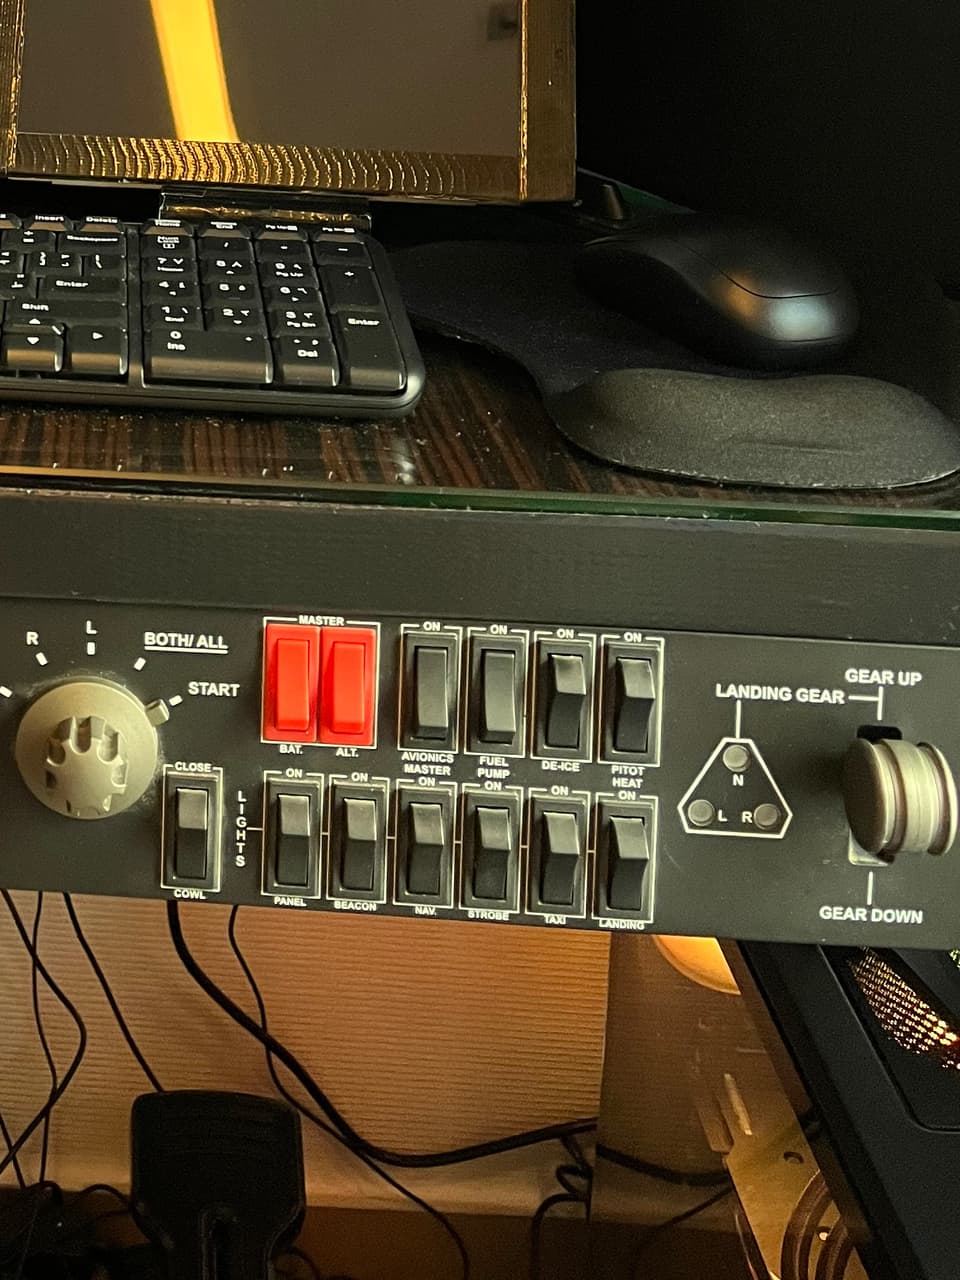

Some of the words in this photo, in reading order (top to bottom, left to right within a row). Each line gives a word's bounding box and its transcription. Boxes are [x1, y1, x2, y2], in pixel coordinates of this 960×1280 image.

[86, 620, 97, 635] L
[298, 615, 345, 628] MASTER
[423, 621, 440, 631] ON
[490, 625, 508, 635] ON
[556, 629, 574, 639] ON
[26, 631, 39, 646] R
[144, 631, 194, 649] BOTH/
[197, 633, 228, 649] ALL
[624, 632, 642, 642] ON
[844, 668, 894, 685] GEAR
[897, 670, 922, 687] UP
[188, 681, 240, 698] START
[715, 683, 792, 701] LANDING
[795, 687, 845, 704] GEAR
[279, 744, 303, 756] BAT.
[336, 747, 359, 759] ALT.
[401, 752, 454, 765] AVIONICS
[479, 756, 508, 768] FUEL
[175, 761, 211, 772] CLOSE
[404, 764, 451, 777] MASTER
[542, 761, 580, 773] DE-ICE
[611, 765, 645, 777] PITOT
[285, 768, 302, 779] ON
[351, 772, 368, 782] ON
[477, 768, 510, 780] PUMP
[418, 776, 436, 787] ON
[612, 777, 642, 789] HEAT
[733, 774, 744, 786] N
[484, 781, 502, 792] ON
[551, 786, 569, 796] ON
[618, 791, 636, 801] ON
[718, 810, 727, 822] L
[742, 812, 752, 823] R
[236, 791, 246, 868] LIGHTS
[173, 888, 206, 901] COWL
[273, 896, 307, 907] PANEL
[334, 901, 377, 913] BEACON
[414, 905, 437, 916] NAV.
[468, 910, 510, 922] STROBE
[819, 906, 867, 922] GEAR
[870, 908, 923, 925] DOWN
[543, 915, 567, 926] TAXI
[599, 919, 645, 932] LANDING
